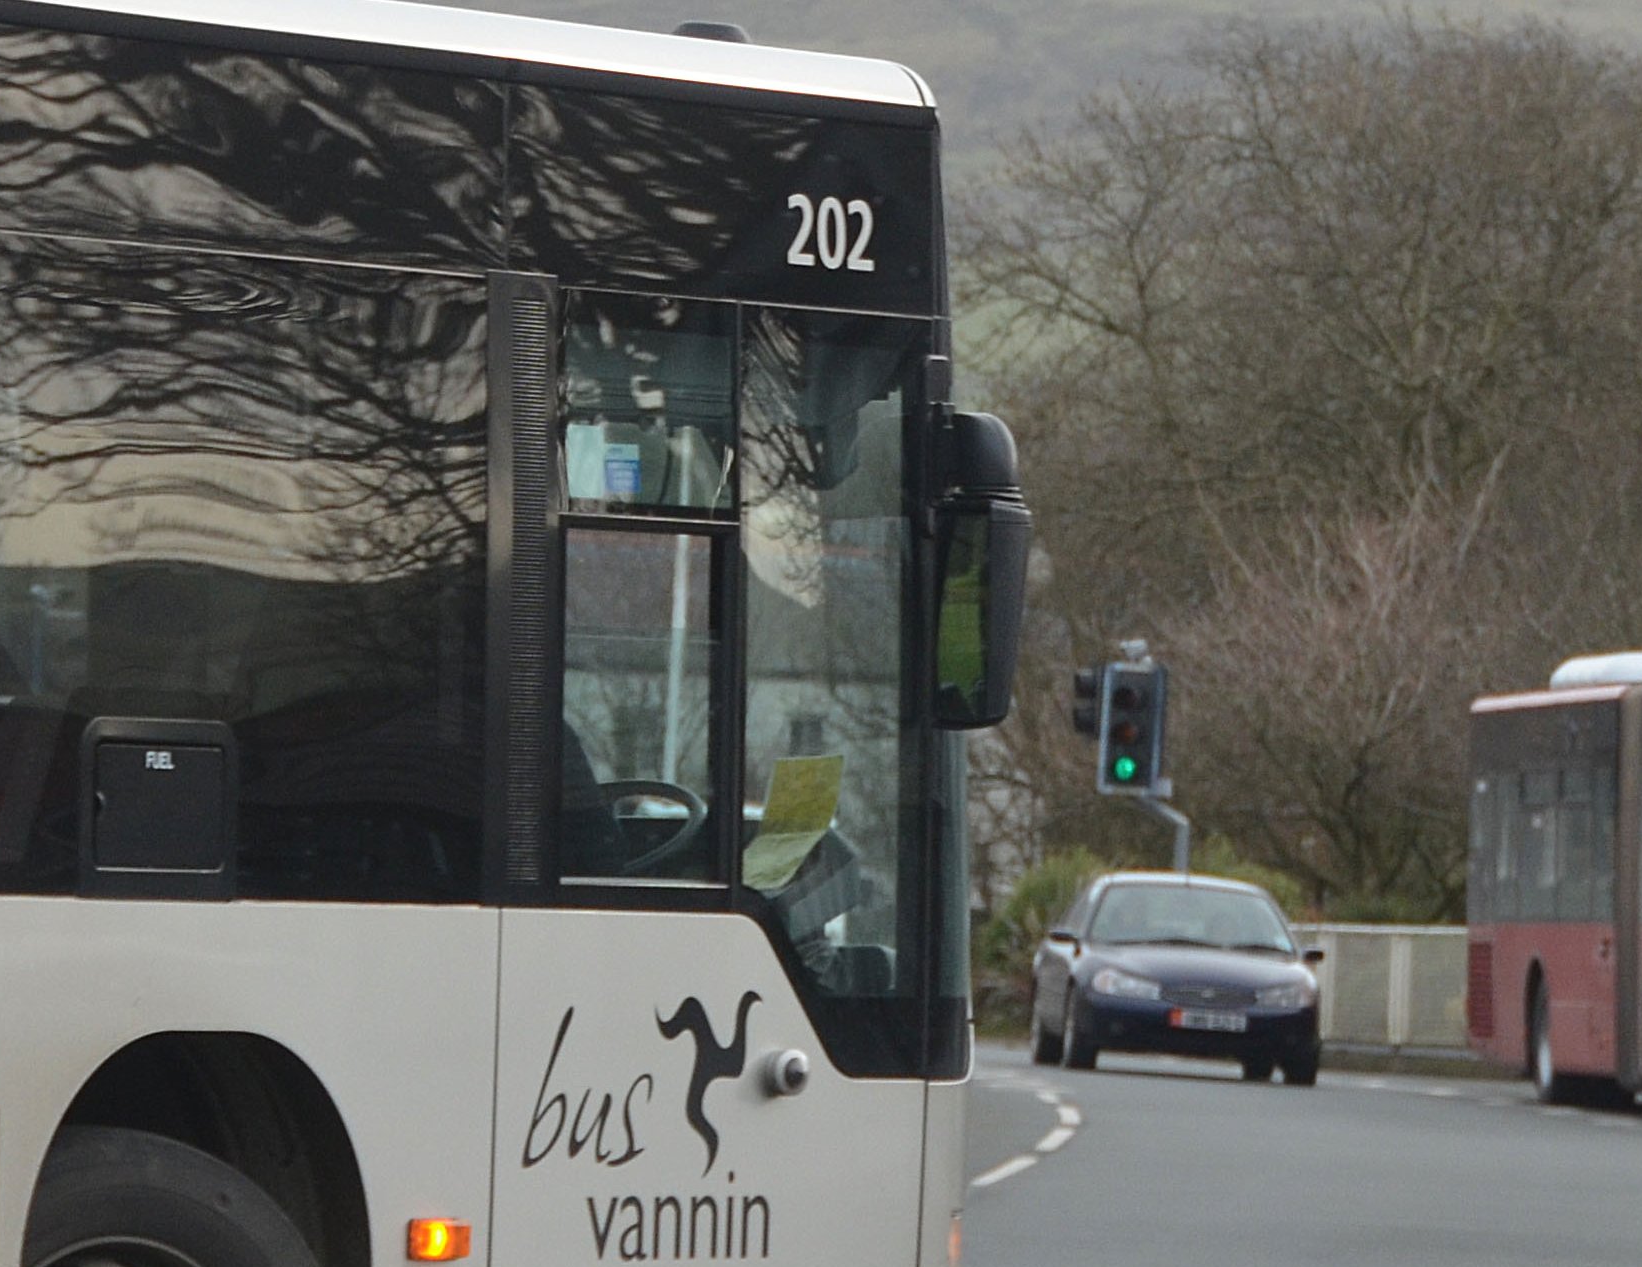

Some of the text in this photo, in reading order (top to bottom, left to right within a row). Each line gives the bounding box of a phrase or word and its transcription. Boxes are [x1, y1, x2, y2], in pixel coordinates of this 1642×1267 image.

[786, 193, 875, 272] 202
[145, 751, 175, 769] FUEL
[521, 1006, 653, 1168] bus
[587, 1171, 771, 1260] vannin
